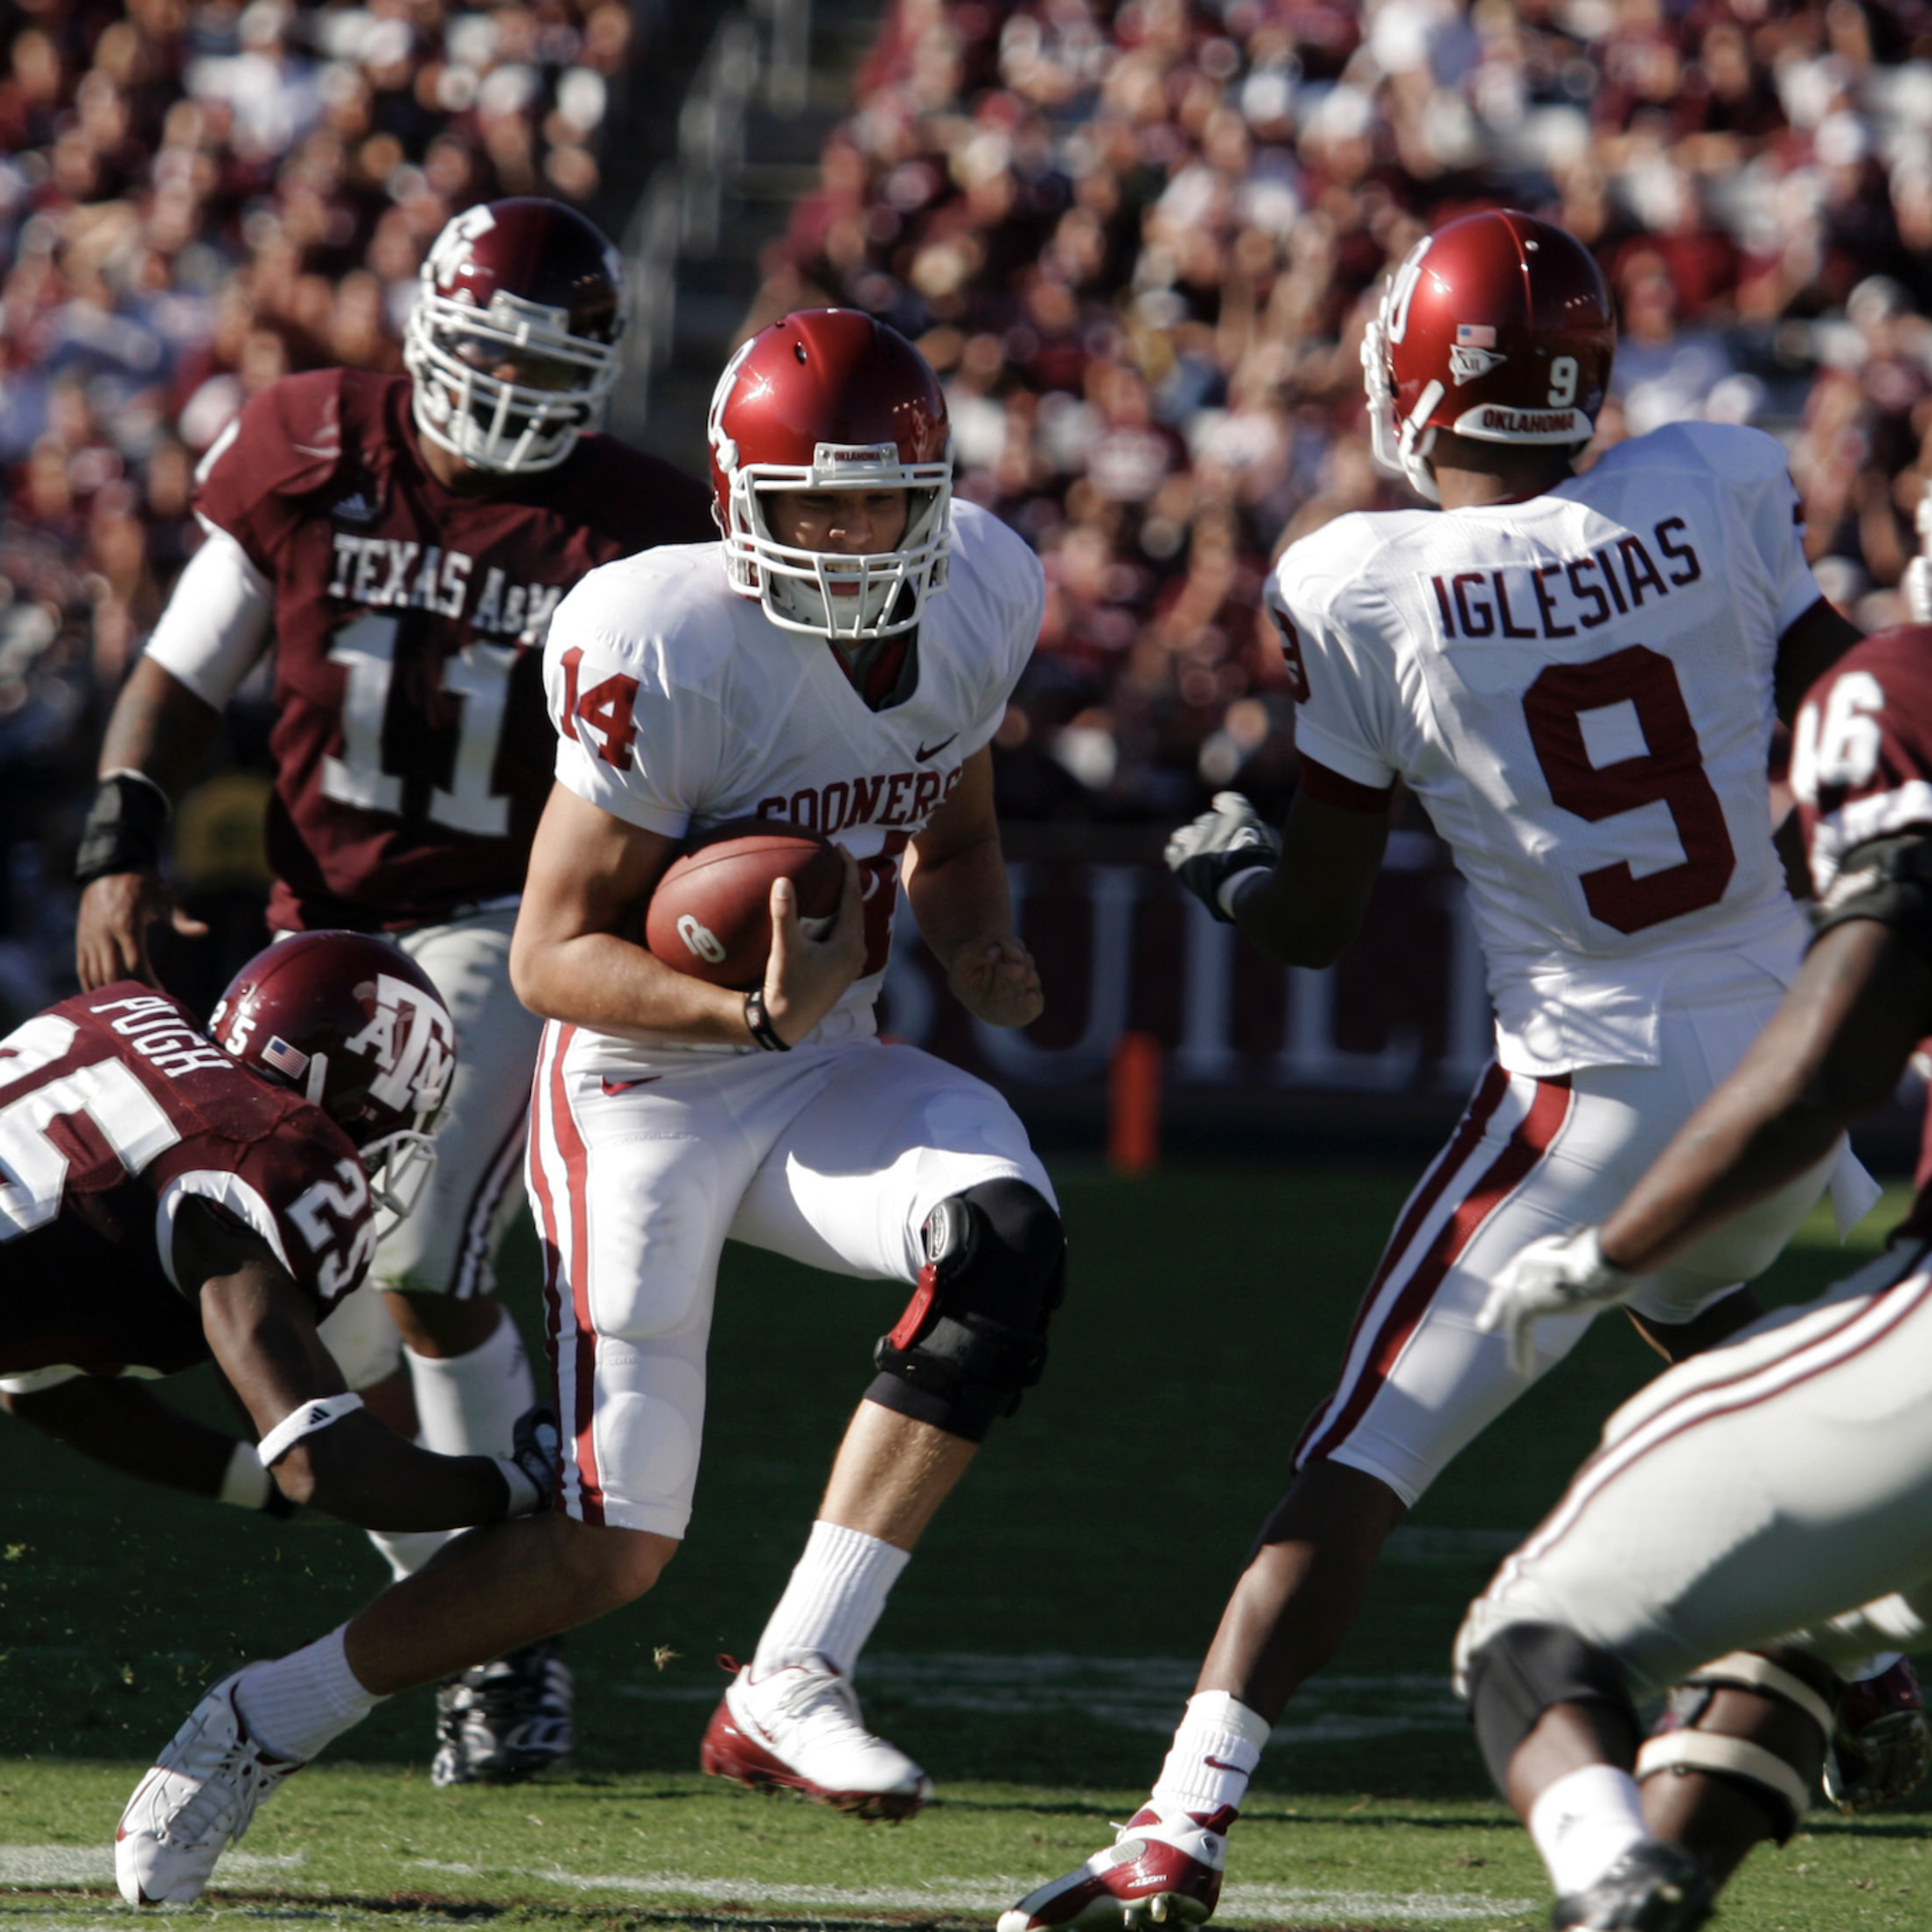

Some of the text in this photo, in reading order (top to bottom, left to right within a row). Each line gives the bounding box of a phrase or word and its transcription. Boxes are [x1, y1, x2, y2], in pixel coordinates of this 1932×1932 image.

[1483, 409, 1575, 432] OKLAHOMA
[1548, 356, 1578, 408] 9
[329, 532, 472, 620] TEXAS
[1432, 517, 1701, 638] IGLESIAS
[320, 611, 512, 837] 11
[560, 646, 640, 771] 14
[1522, 643, 1736, 935] 9
[90, 996, 233, 1078] PUGH
[209, 1000, 257, 1056] 25
[284, 1158, 378, 1299] 25
